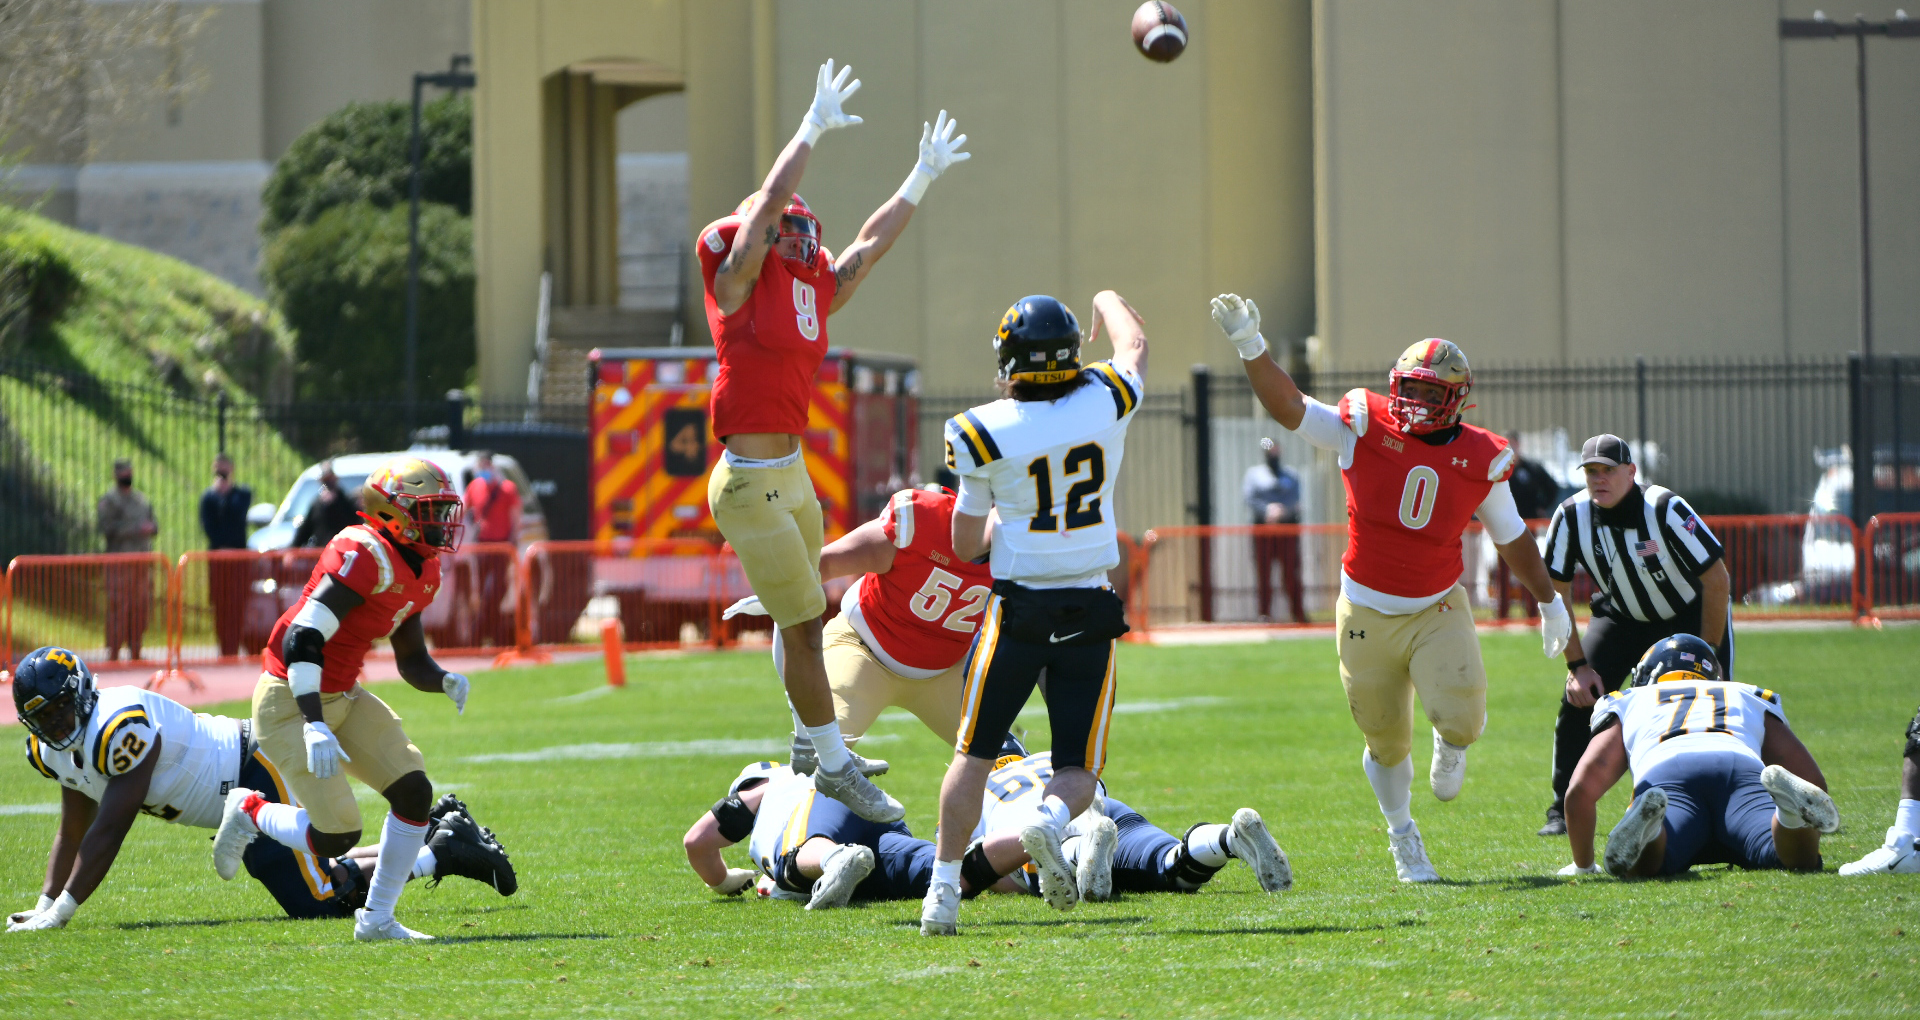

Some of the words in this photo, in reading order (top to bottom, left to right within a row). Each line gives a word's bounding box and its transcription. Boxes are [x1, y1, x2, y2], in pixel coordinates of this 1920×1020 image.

[792, 276, 819, 341] 9
[1033, 371, 1067, 382] ETSU
[1046, 360, 1057, 370] 12
[670, 422, 699, 462] 4
[1027, 440, 1106, 533] 12
[1398, 465, 1439, 530] 0
[338, 550, 359, 577] 1
[1652, 569, 1667, 582] U
[909, 566, 993, 633] 52
[1656, 686, 1734, 744] 71
[112, 731, 148, 773] 52
